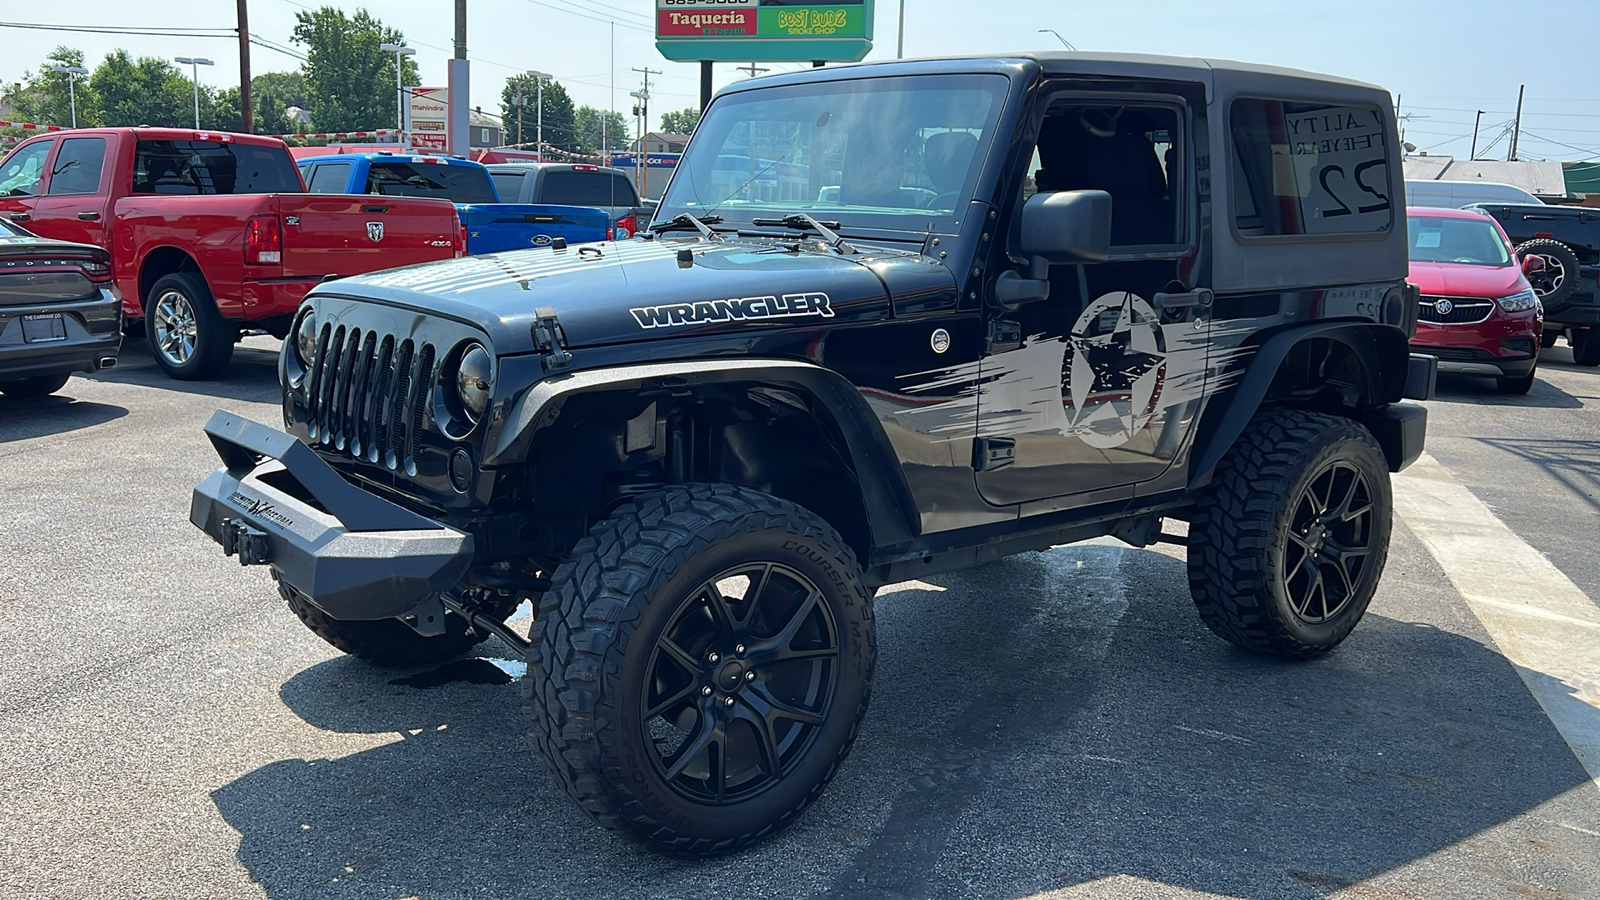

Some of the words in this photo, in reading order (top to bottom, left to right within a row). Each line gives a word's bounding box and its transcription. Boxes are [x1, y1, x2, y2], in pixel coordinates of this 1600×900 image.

[810, 9, 846, 28] BUDZ
[814, 27, 836, 35] SHOP
[629, 292, 835, 329] WRANGLER
[782, 540, 854, 608] COURSER
